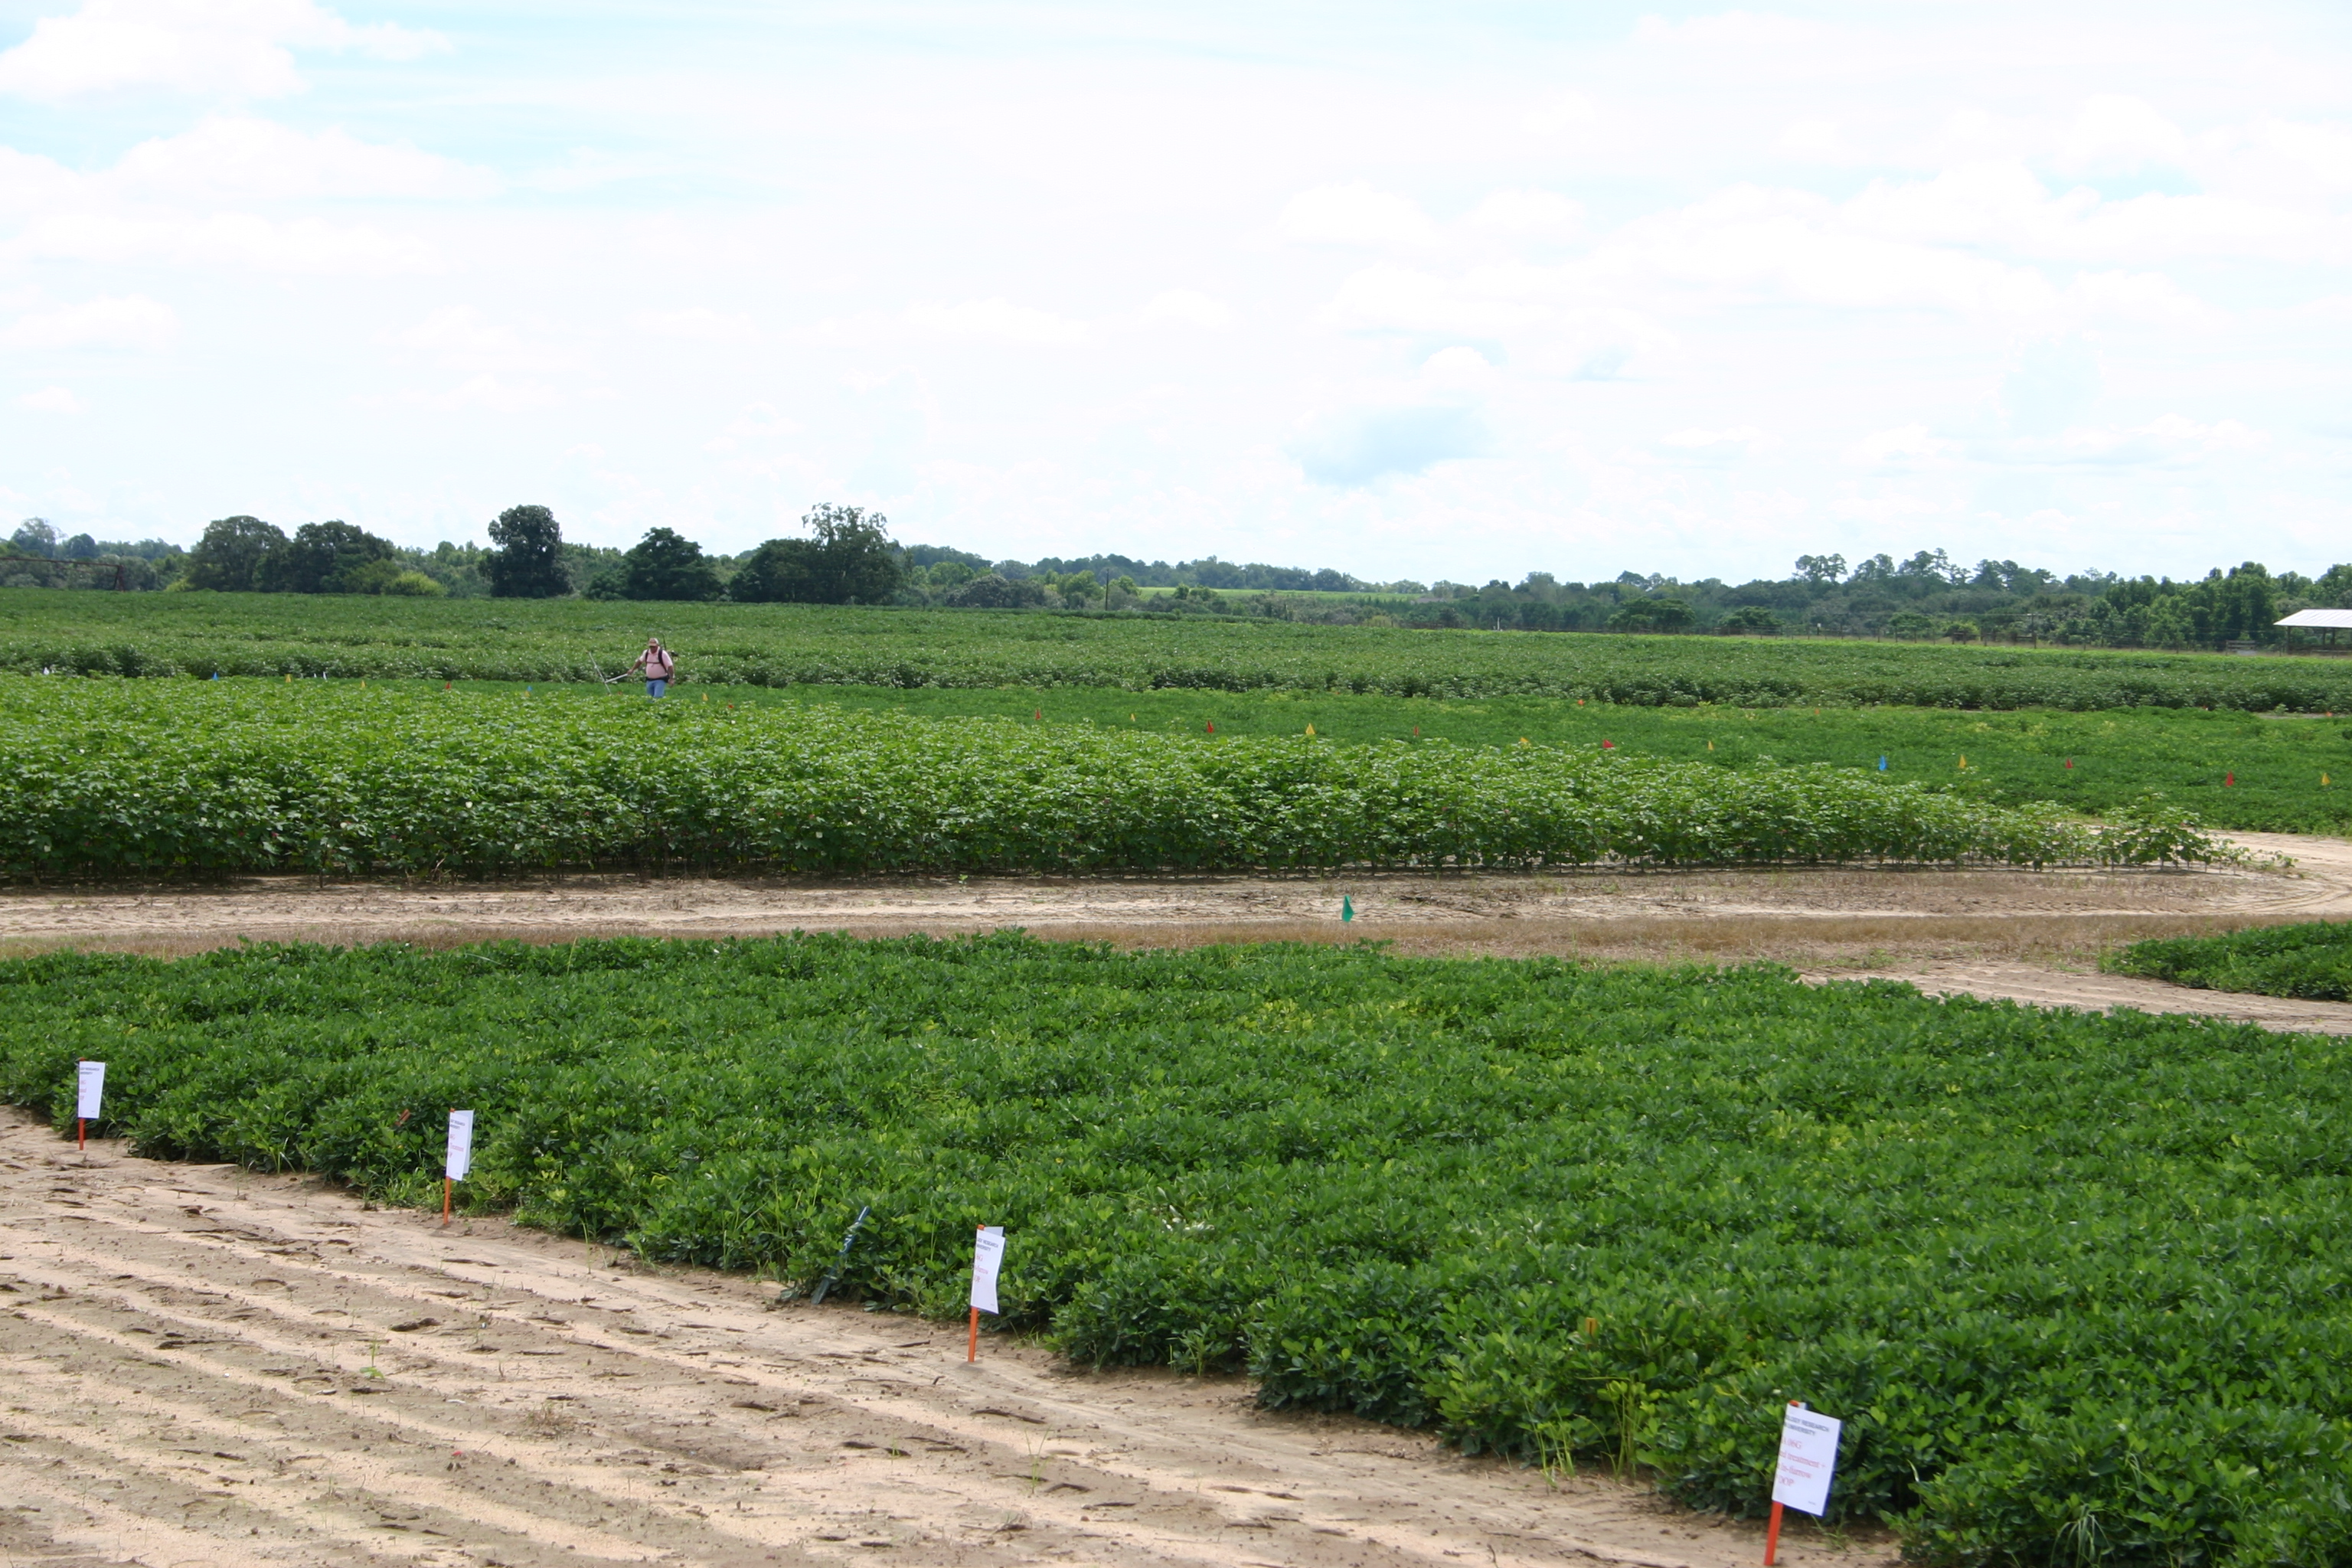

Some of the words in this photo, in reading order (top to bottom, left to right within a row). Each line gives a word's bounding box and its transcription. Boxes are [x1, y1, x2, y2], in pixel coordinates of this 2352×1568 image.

[1787, 1423, 1816, 1436] UNIVERSITY
[1801, 1419, 1829, 1432] RESEARCH
[1787, 1452, 1820, 1468] treatment
